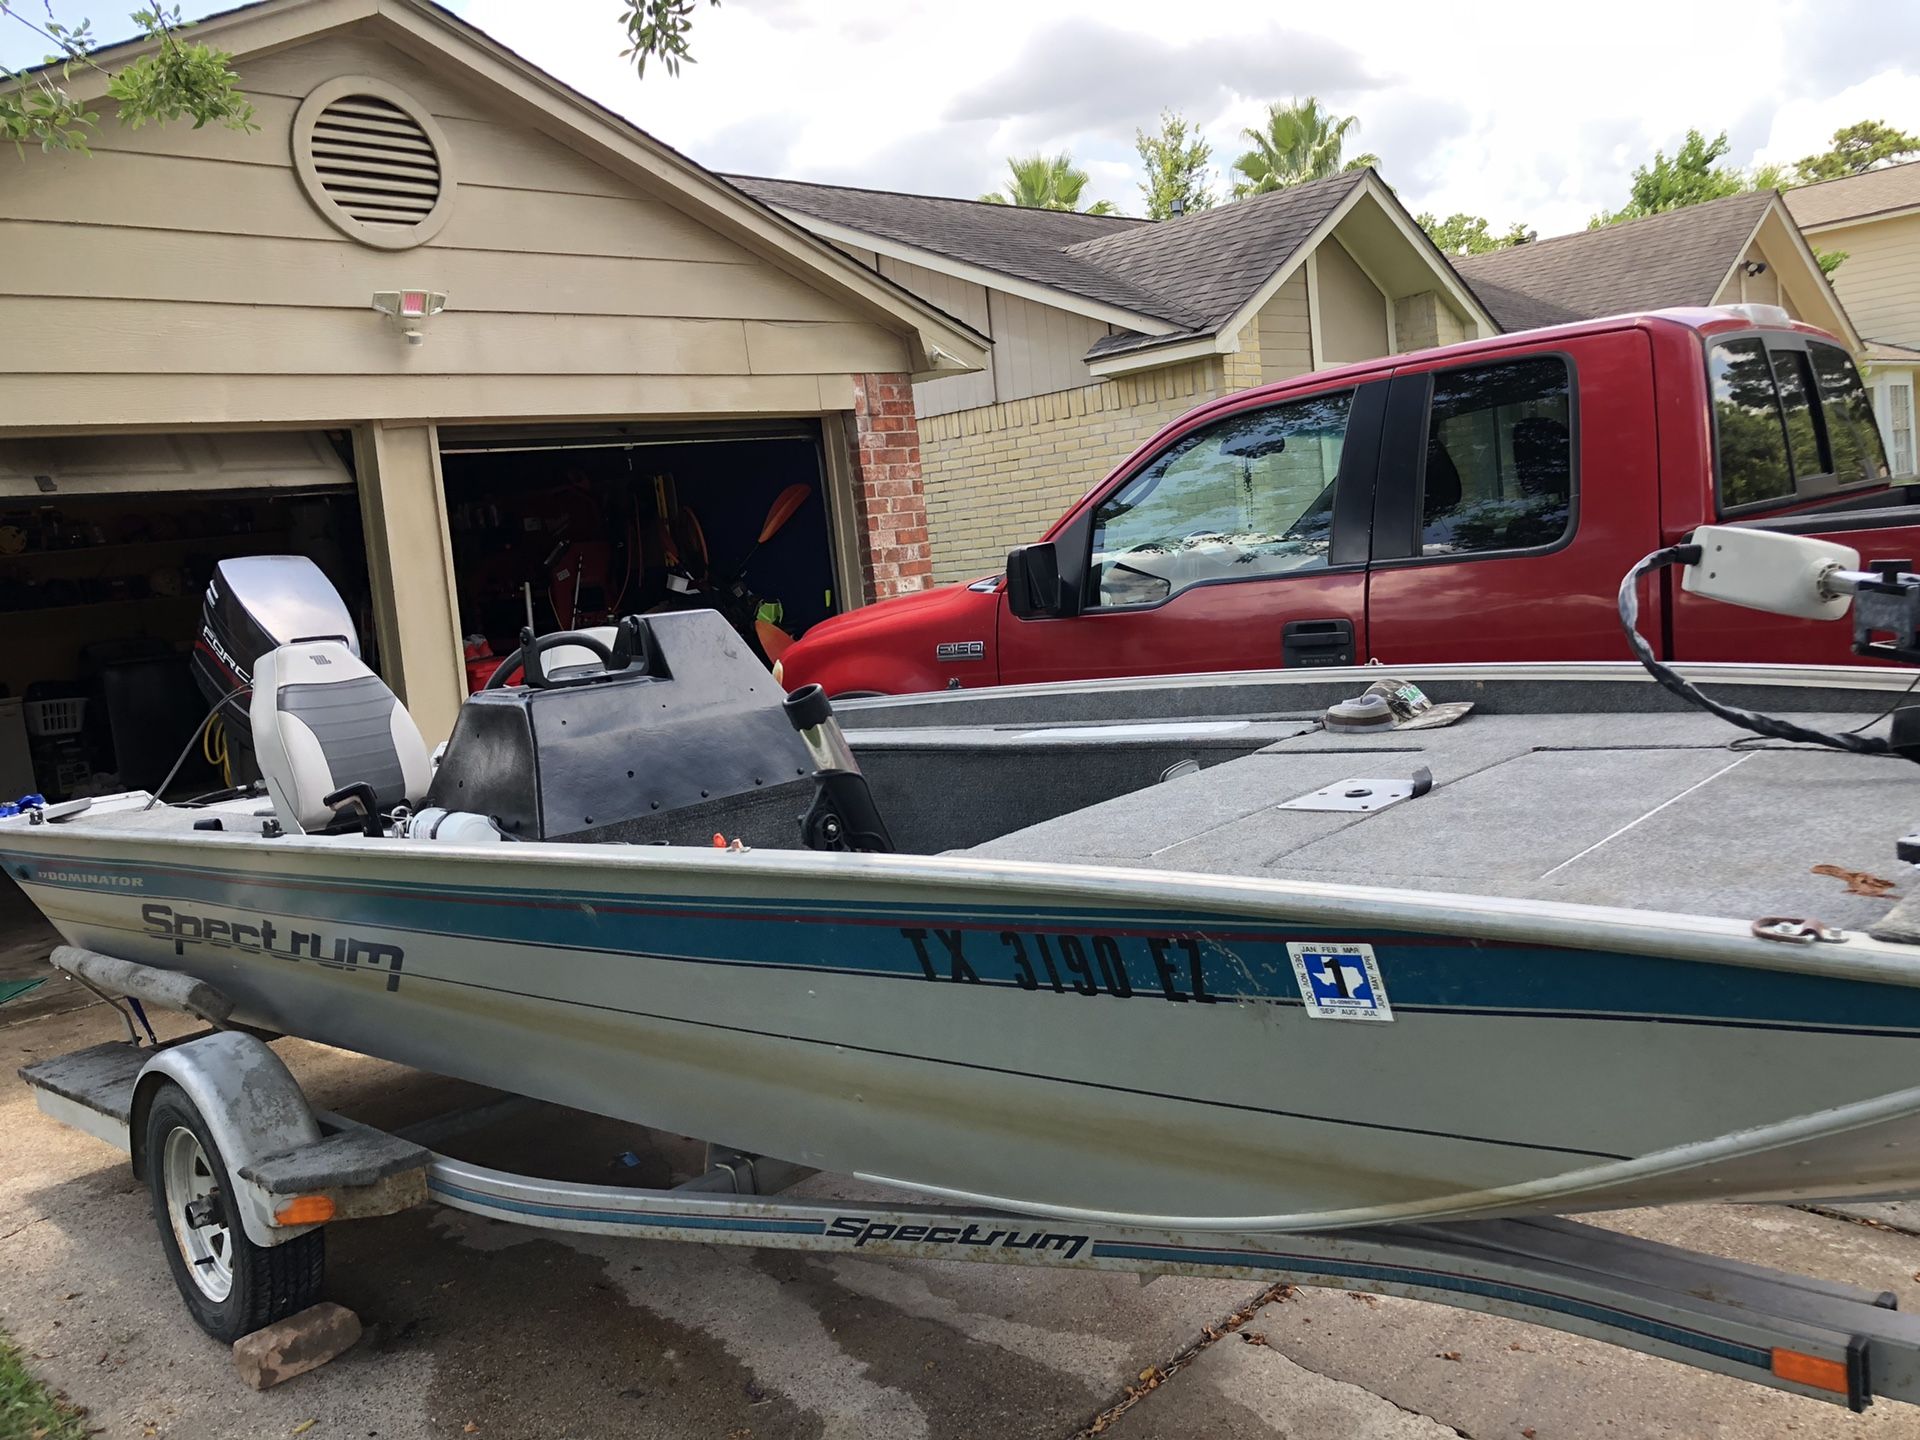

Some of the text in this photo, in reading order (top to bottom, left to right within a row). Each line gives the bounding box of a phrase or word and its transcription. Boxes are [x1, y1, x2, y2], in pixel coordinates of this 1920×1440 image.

[203, 625, 254, 689] FORC
[47, 871, 144, 887] DOMINATOR
[141, 902, 405, 992] Spectrum
[901, 928, 981, 983] TX
[1000, 931, 1132, 998] 3190
[1293, 953, 1304, 968] DEC
[1364, 955, 1373, 970] APR
[1300, 973, 1310, 986] NOV
[1323, 959, 1353, 999] 1
[1369, 976, 1380, 990] MAY
[1305, 992, 1316, 1005] OCT
[1375, 995, 1386, 1008] JUN
[1341, 1008, 1358, 1016] AUG
[825, 1216, 1089, 1259] Spectrum
